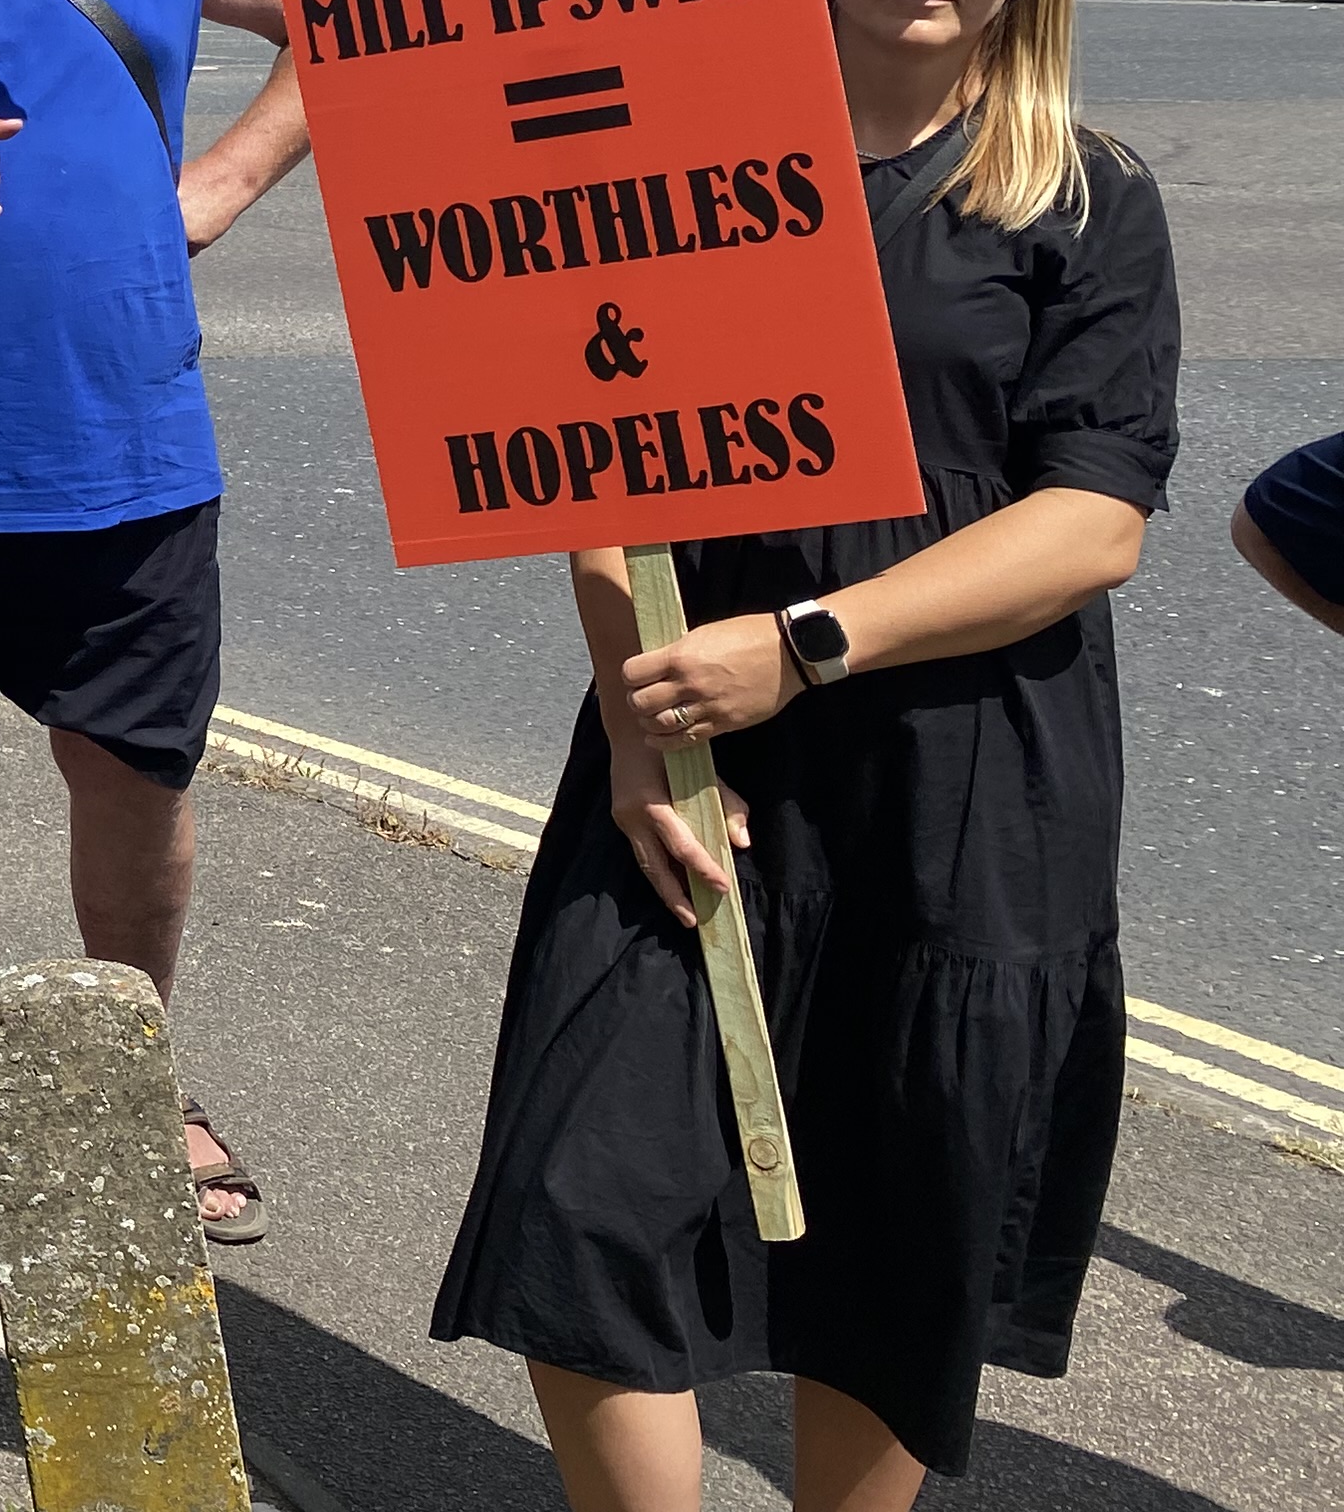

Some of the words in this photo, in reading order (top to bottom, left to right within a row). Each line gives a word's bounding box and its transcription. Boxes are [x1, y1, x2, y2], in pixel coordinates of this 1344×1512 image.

[363, 152, 824, 293] WORTHLESS
[584, 302, 649, 382] &
[444, 393, 835, 514] HOPELESS
